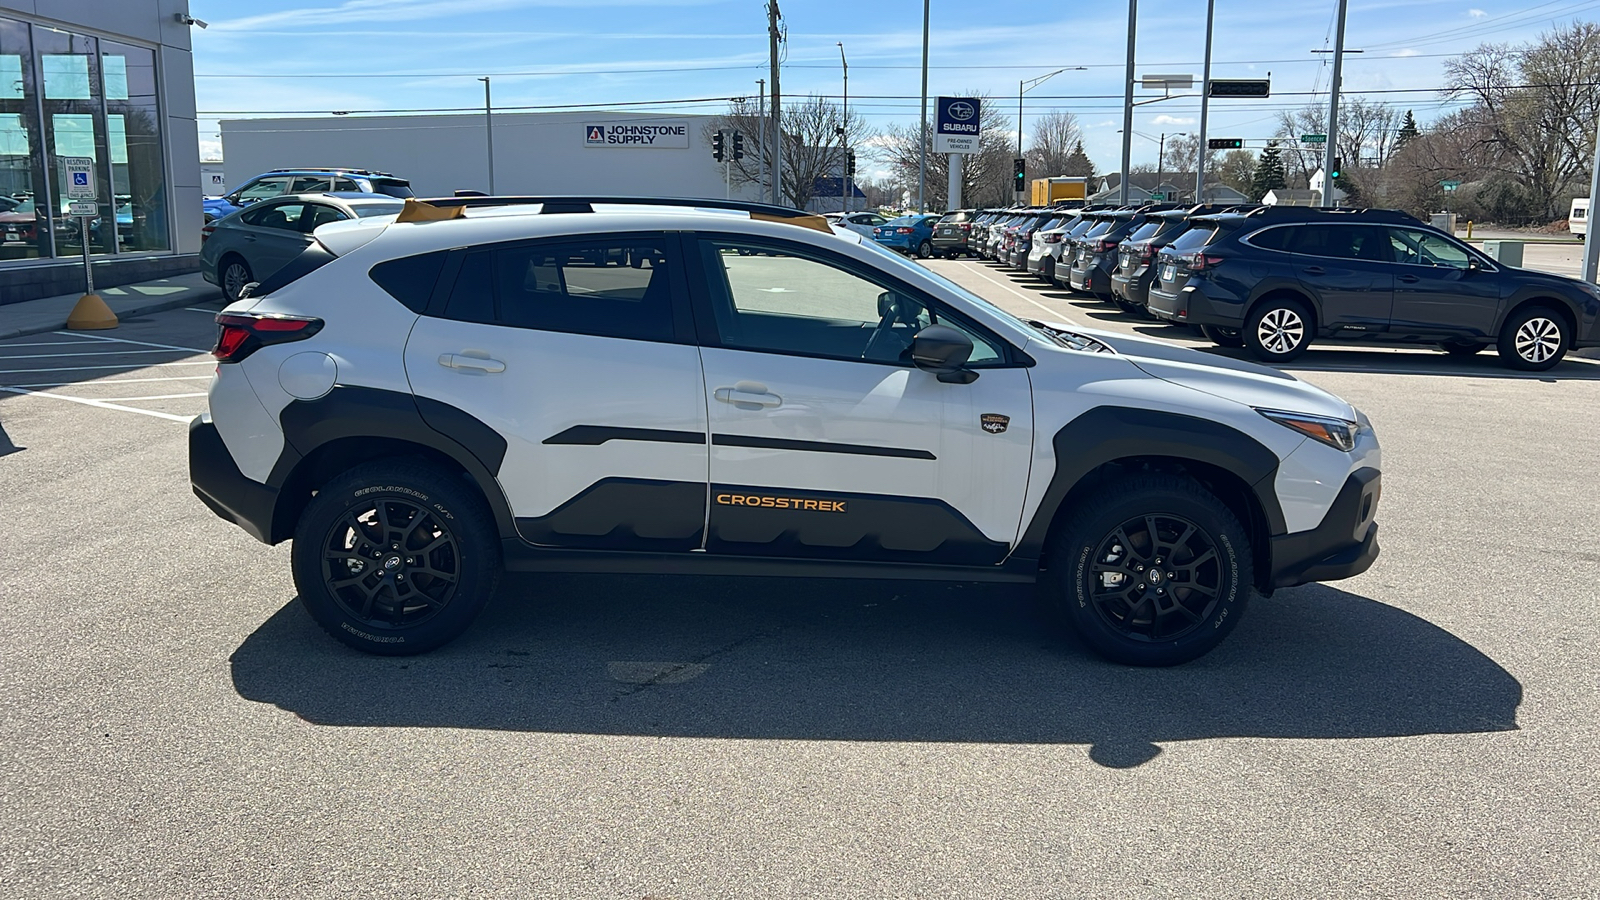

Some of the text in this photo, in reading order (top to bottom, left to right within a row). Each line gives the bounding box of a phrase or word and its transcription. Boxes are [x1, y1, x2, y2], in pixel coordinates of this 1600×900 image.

[607, 126, 685, 135] JOHNSTONE
[943, 123, 977, 132] SUBARU
[607, 135, 656, 144] SUPPLY
[354, 486, 454, 520] GEOLANDAR A/T
[716, 494, 846, 512] CROSSTREK
[1076, 546, 1091, 608] YOKOHAMA
[1214, 534, 1239, 629] GEOLANDAR A/T
[340, 621, 405, 644] YOKOHAMA
